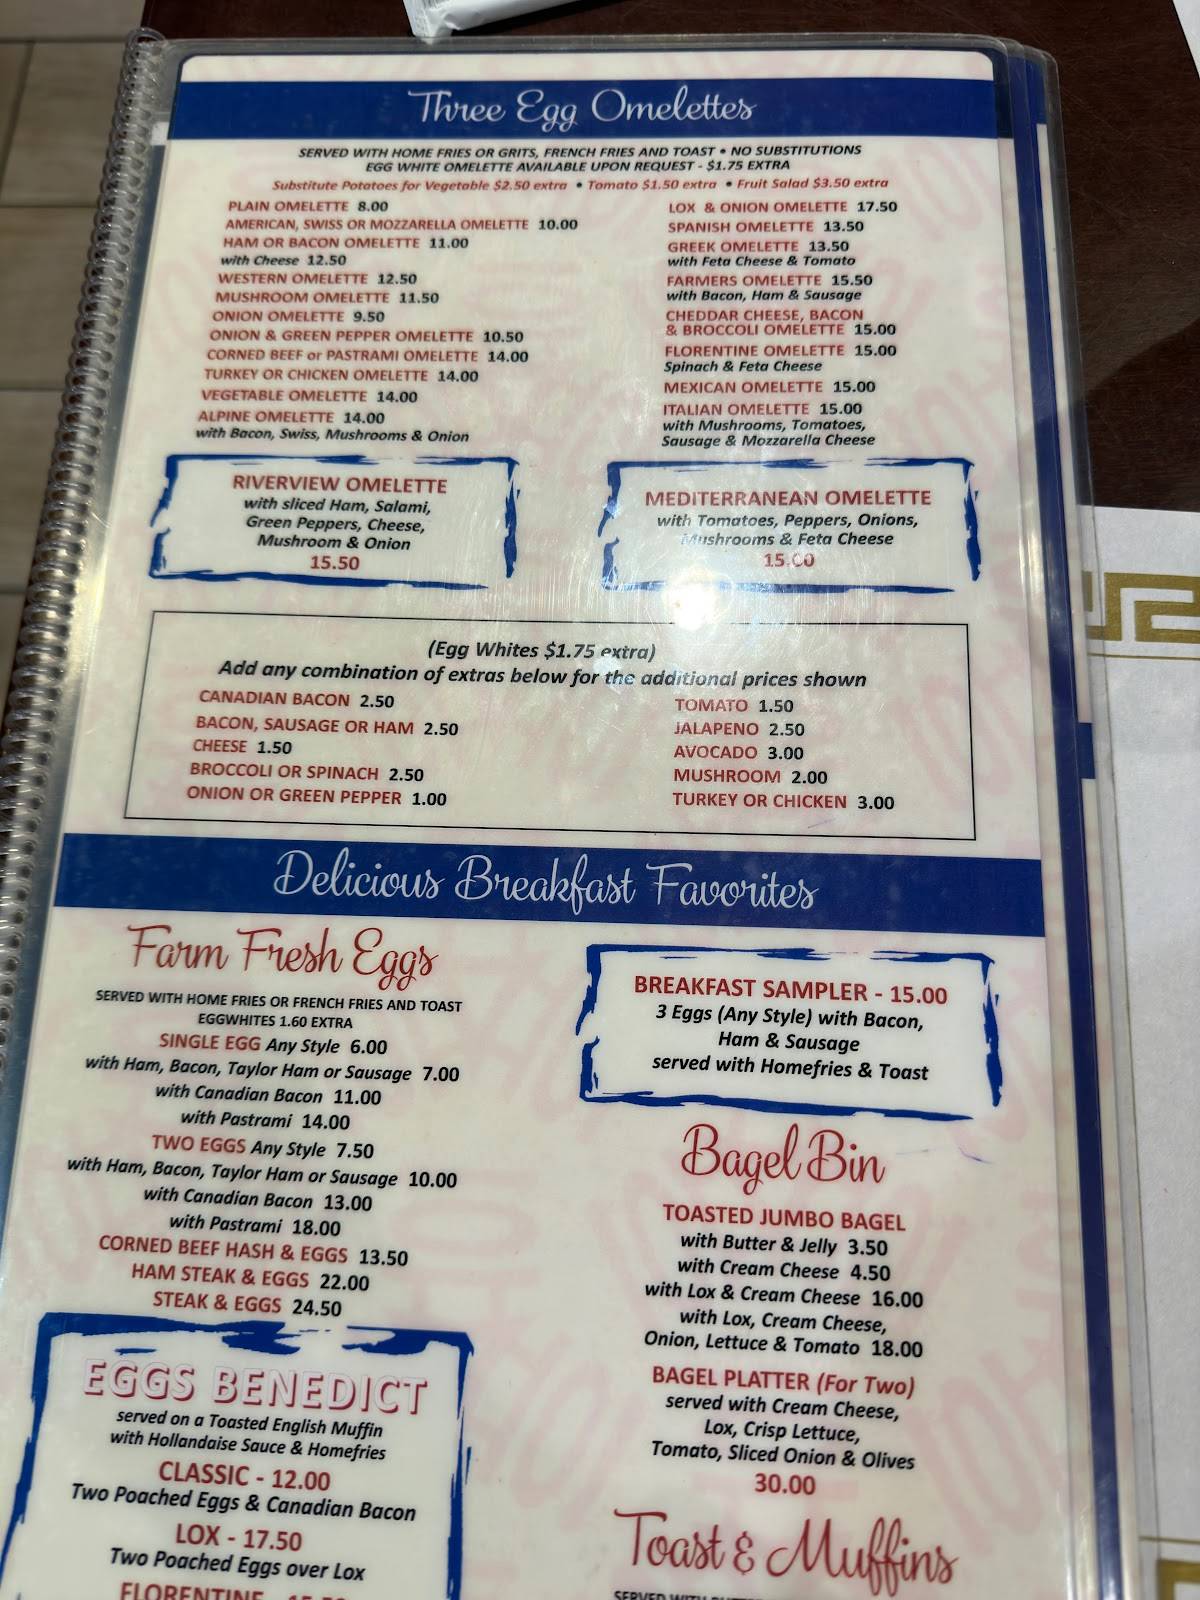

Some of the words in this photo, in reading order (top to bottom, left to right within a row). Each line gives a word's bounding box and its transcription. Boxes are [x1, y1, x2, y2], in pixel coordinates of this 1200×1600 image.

[408, 90, 506, 122] Three
[517, 89, 577, 132] Egg
[592, 84, 757, 122] Omelettes
[298, 148, 349, 158] SERVED
[353, 148, 389, 158] WITH
[391, 148, 433, 158] HOME
[437, 148, 472, 158] FRIES
[475, 148, 495, 158] OR
[498, 148, 539, 159] GRITS,
[544, 147, 596, 158] FRENCH
[600, 147, 635, 157] FRIES
[638, 147, 669, 157] AND
[673, 146, 716, 157] TOAST
[731, 146, 752, 156] NO
[755, 145, 862, 156] SUBSTITUTIONS
[272, 180, 338, 191] Substitute
[342, 180, 399, 191] Potatoes
[400, 180, 421, 192] for
[425, 180, 490, 193] Vegetable
[493, 179, 531, 192] $2.50
[533, 181, 568, 190] extra
[588, 180, 639, 190] Tomato
[642, 179, 680, 191] $1.50
[682, 180, 717, 190] extra
[737, 178, 768, 189] Fruit
[771, 178, 809, 189] Salad
[812, 177, 851, 189] $3.50
[853, 178, 889, 188] extra
[228, 201, 270, 212] PLAIN
[274, 201, 349, 212] OMELETTE
[357, 201, 389, 212] 8.00
[669, 203, 695, 214] LOX
[704, 202, 715, 213] &
[720, 202, 769, 213] ONION
[773, 201, 847, 213] OMELETTE
[857, 201, 898, 212] 17.50
[668, 222, 730, 233] SPANISH
[736, 221, 813, 232] OMELETTE
[824, 220, 864, 232] 13.50
[668, 256, 698, 267] with
[702, 256, 731, 267] Feta
[735, 256, 783, 266] Cheese
[786, 255, 798, 266] &
[803, 255, 856, 266] Tomato
[215, 291, 309, 303] MUSHROOM
[313, 292, 390, 303] OMELETTE
[399, 292, 440, 304] 11.50
[666, 310, 738, 322] CHEDDAR
[743, 309, 804, 323] CHEESE,
[810, 309, 864, 321] BACON
[664, 382, 736, 394] MEXICAN
[741, 381, 823, 393] OMELETTE
[833, 380, 876, 393] 15.00
[196, 427, 226, 438] with
[230, 427, 275, 441] Bacon,
[279, 428, 320, 441] Swiss,
[325, 428, 408, 441] Mushrooms
[411, 430, 423, 442] &
[427, 430, 469, 442] Onion
[233, 475, 341, 491] RIVERVIEW
[346, 477, 447, 494] OMELETTE
[244, 497, 278, 509] with
[282, 497, 326, 511] sliced
[329, 499, 369, 514] Ham,
[374, 500, 431, 516] Salami,
[646, 490, 818, 506] MEDITERRANEAN
[825, 490, 931, 505] OMELETTE
[310, 555, 360, 570] 15.50
[428, 640, 470, 660] (Egg
[476, 641, 539, 658] Whites
[544, 641, 595, 660] $1.75
[600, 644, 656, 663] extra)
[199, 690, 287, 705] CANADIAN
[292, 693, 350, 707] BACON
[360, 694, 395, 708] 2.50
[675, 698, 748, 712] TOMATO
[759, 699, 794, 713] 1.50
[193, 739, 248, 753] CHEESE
[257, 741, 293, 755] 1.50
[190, 762, 272, 777] BROCCOLI
[278, 765, 302, 778] OR
[306, 765, 379, 780] SPINACH
[389, 768, 424, 782] 2.50
[672, 792, 738, 807] TURKEY
[743, 794, 767, 807] OR
[773, 794, 847, 808] CHICKEN
[858, 795, 895, 810] 3.00
[274, 847, 445, 899] Delicious
[455, 853, 636, 914] Breakfast
[646, 863, 819, 910] Favorites
[127, 924, 229, 970] Farm
[236, 927, 344, 973] Fresh
[352, 927, 439, 992] Eggs
[635, 975, 757, 997] BREAKFAST
[763, 980, 868, 1001] SAMPLER
[891, 986, 947, 1005] 15.00
[198, 1013, 275, 1027] EGGWHITES
[279, 1016, 307, 1028] 1.60
[311, 1016, 353, 1029] EXTRA
[656, 1004, 667, 1019] 3
[672, 1004, 712, 1024] Eggs
[718, 1005, 759, 1026] (Any
[762, 1008, 812, 1028] Style)
[818, 1010, 858, 1026] with
[864, 1012, 923, 1032] Bacon,
[160, 1033, 219, 1049] SINGLE
[225, 1036, 261, 1051] EGG
[265, 1038, 298, 1055] Any
[300, 1038, 340, 1056] Style
[350, 1039, 388, 1055] 6.00
[156, 1083, 190, 1098] with
[195, 1085, 269, 1101] Canadian
[274, 1088, 323, 1104] Bacon
[334, 1089, 382, 1106] 11.00
[681, 1123, 802, 1196] Bagel
[807, 1129, 885, 1184] Bin
[662, 1204, 754, 1224] TOASTED
[759, 1208, 834, 1229] JUMBO
[841, 1212, 906, 1231] BAGEL
[681, 1232, 717, 1248] with
[722, 1234, 777, 1251] Butter
[781, 1236, 794, 1252] &
[799, 1238, 838, 1257] Jelly
[848, 1239, 888, 1256] 3.50
[132, 1263, 176, 1280] HAM
[181, 1266, 236, 1284] STEAK
[241, 1269, 255, 1285] &
[262, 1270, 309, 1288] EGGS
[320, 1273, 370, 1292] 22.00
[84, 1361, 195, 1402] EGGS
[214, 1371, 428, 1415] BENEDICT
[653, 1366, 718, 1386] BAGEL
[724, 1369, 810, 1391] PLATTER
[817, 1372, 858, 1396] (For
[864, 1376, 915, 1400] Two)
[116, 1410, 168, 1424] served
[170, 1414, 190, 1426] on
[194, 1416, 205, 1427] a
[210, 1414, 269, 1431] Toasted
[272, 1418, 327, 1436] English
[330, 1421, 383, 1440] Muffin
[704, 1419, 737, 1439] Lox,
[744, 1421, 787, 1442] Crisp
[792, 1423, 860, 1445] Lettuce,
[755, 1473, 816, 1495] 30.00
[613, 1508, 725, 1570] Toast
[732, 1531, 755, 1576] &
[766, 1516, 958, 1597] Muffins
[111, 1547, 149, 1566] Two
[153, 1550, 234, 1572] Poached
[237, 1556, 282, 1579] Eggs
[286, 1563, 329, 1578] over
[333, 1562, 366, 1581] Lox
